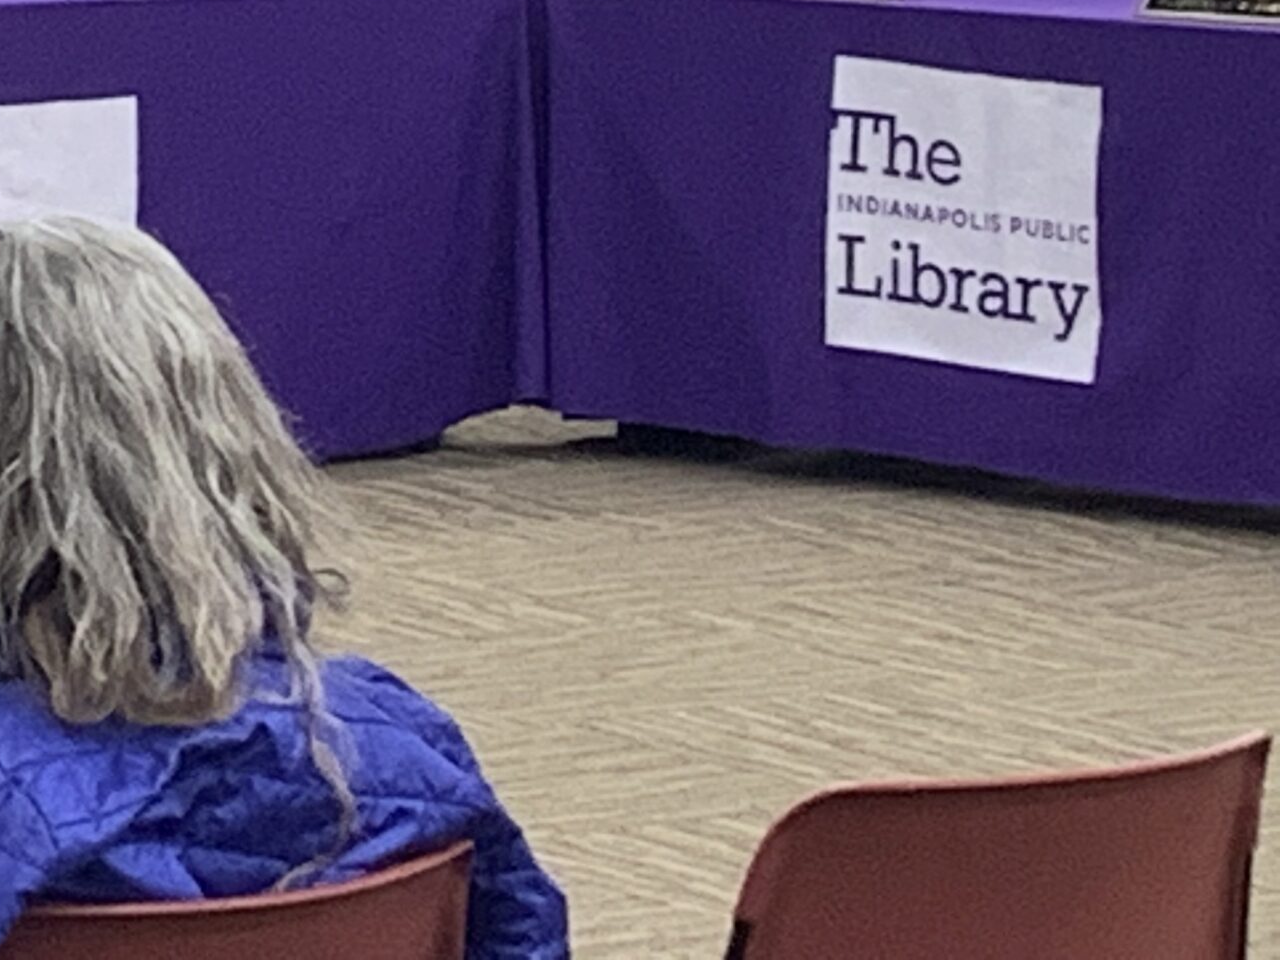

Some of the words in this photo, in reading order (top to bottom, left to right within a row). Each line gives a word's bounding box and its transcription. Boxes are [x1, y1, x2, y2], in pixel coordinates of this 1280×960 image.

[831, 109, 962, 186] The
[836, 193, 1002, 234] INDIANAPOLIS
[1009, 216, 1091, 245] PUBLIC
[836, 233, 1090, 342] Library
